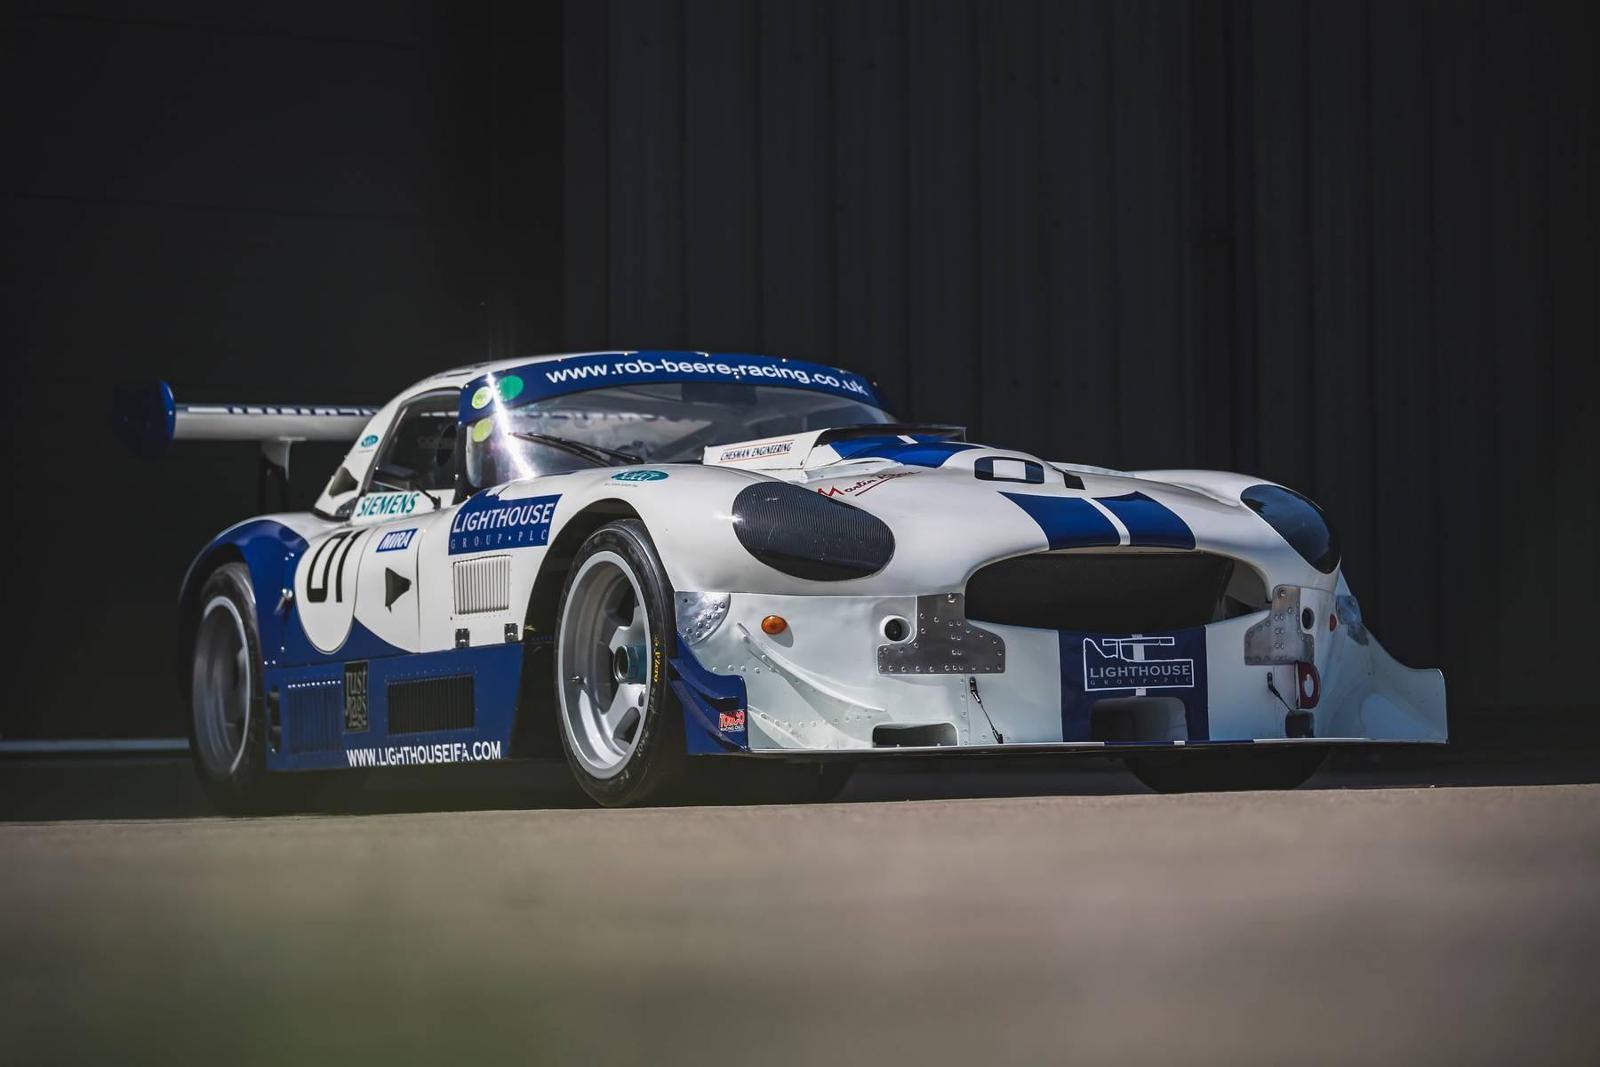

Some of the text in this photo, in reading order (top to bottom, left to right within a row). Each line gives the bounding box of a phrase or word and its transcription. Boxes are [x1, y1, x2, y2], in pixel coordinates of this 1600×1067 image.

[546, 359, 869, 397] www.rob-beere-racing.co.uk
[752, 442, 794, 457] ENGINEERING
[357, 493, 420, 516] SIEMENS
[452, 503, 555, 533] LIGHTHOUSE
[380, 531, 411, 550] MIRA
[1090, 664, 1191, 678] LIGHTHOUSE
[347, 741, 501, 767] WWW.LIGHTHOUSEIFA.COM
